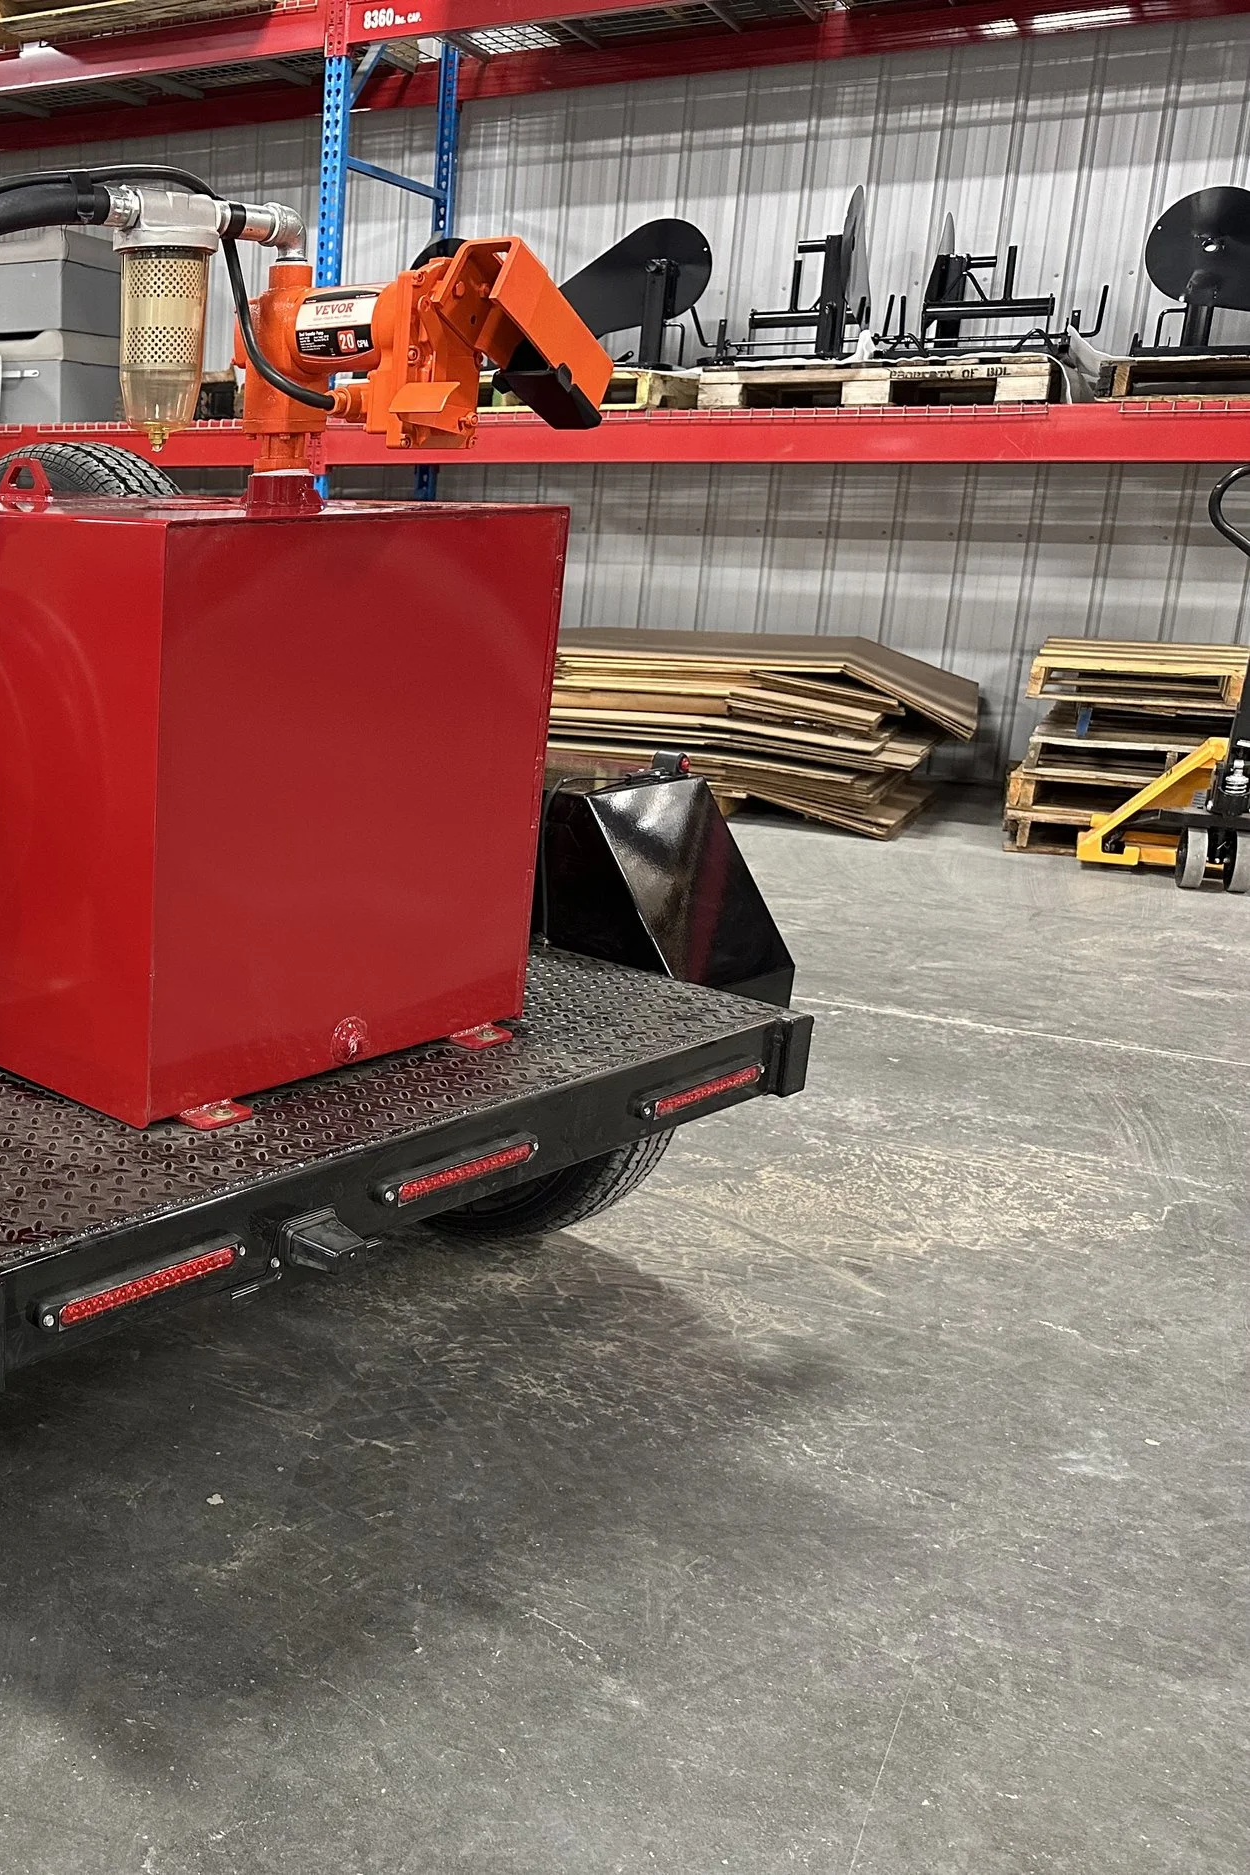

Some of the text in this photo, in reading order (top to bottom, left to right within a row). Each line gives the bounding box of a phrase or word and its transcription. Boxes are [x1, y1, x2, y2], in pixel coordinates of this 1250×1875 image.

[363, 7, 395, 30] 8360
[315, 303, 354, 315] VEVOR
[339, 334, 354, 349] 20
[357, 340, 369, 348] GPM
